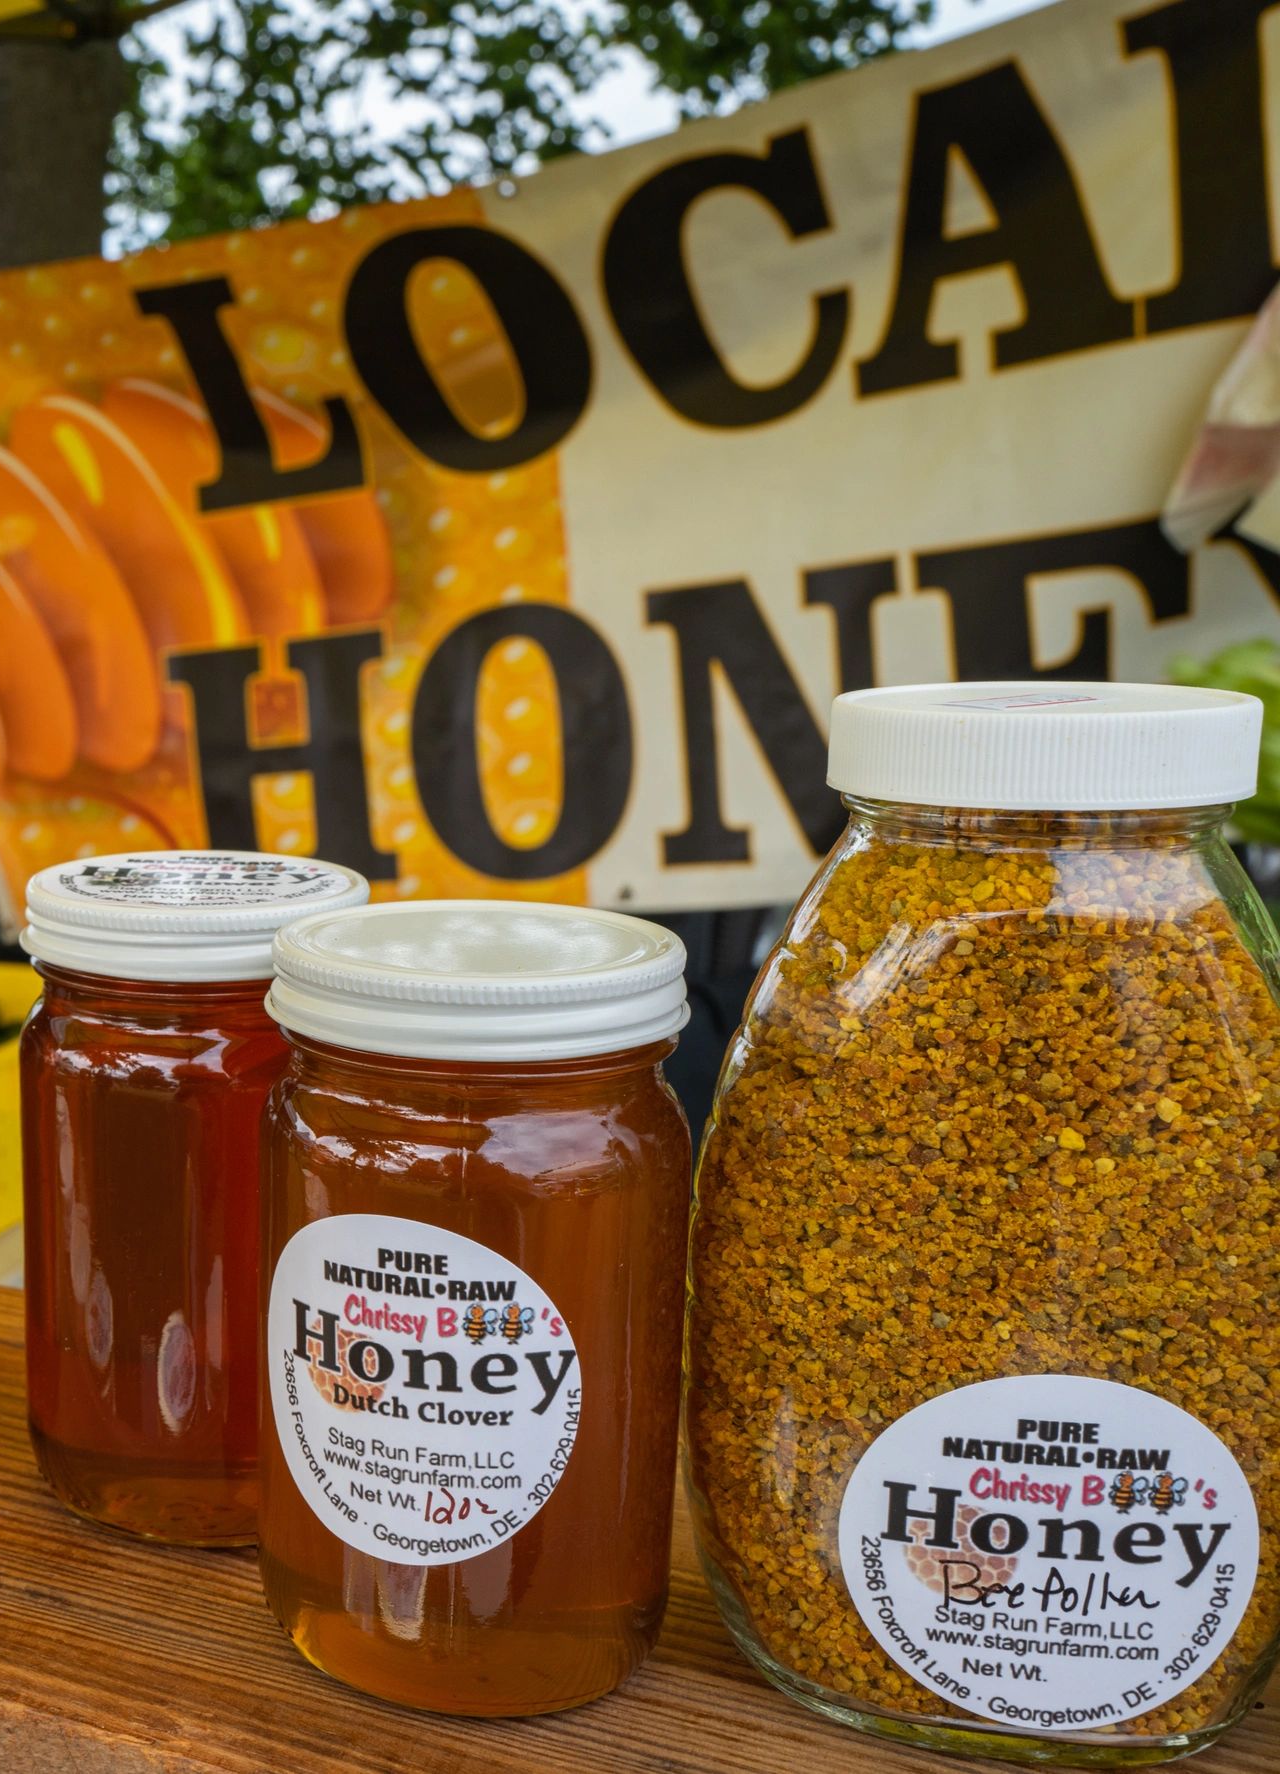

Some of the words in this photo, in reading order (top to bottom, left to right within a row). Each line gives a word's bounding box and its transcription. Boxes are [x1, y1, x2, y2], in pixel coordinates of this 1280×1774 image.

[377, 1247, 449, 1276] PURE
[343, 1293, 428, 1344] Chrissy
[284, 1348, 299, 1406] 23656
[292, 1297, 577, 1416] Honey
[332, 1382, 409, 1420] Dutch
[417, 1401, 514, 1427] Clover
[291, 1411, 327, 1484] Foxcroft
[328, 1426, 366, 1457] Stag
[370, 1438, 410, 1463] Run
[1016, 1418, 1100, 1445] PURE
[323, 1447, 523, 1490] www.stagrunfarm.com
[322, 1481, 360, 1523] Lane
[350, 1480, 383, 1505] Net
[387, 1490, 421, 1512] Wt.
[969, 1466, 1072, 1513] Chrissy
[372, 1523, 493, 1557] Georgetown,
[489, 1510, 523, 1538] DE
[880, 1480, 1232, 1589] Honey
[860, 1535, 887, 1592] 23656
[938, 1559, 1025, 1609] Bee
[871, 1594, 930, 1666] Foxcroft
[934, 1604, 986, 1632] Stag
[992, 1611, 1038, 1633] Run
[924, 1626, 1160, 1662] www.stagrunfarm.com
[921, 1659, 971, 1700] Lane
[961, 1657, 1003, 1678] Net
[1009, 1662, 1048, 1683] Wt.
[987, 1696, 1124, 1728] Georgetown,
[1121, 1681, 1158, 1709] DE
